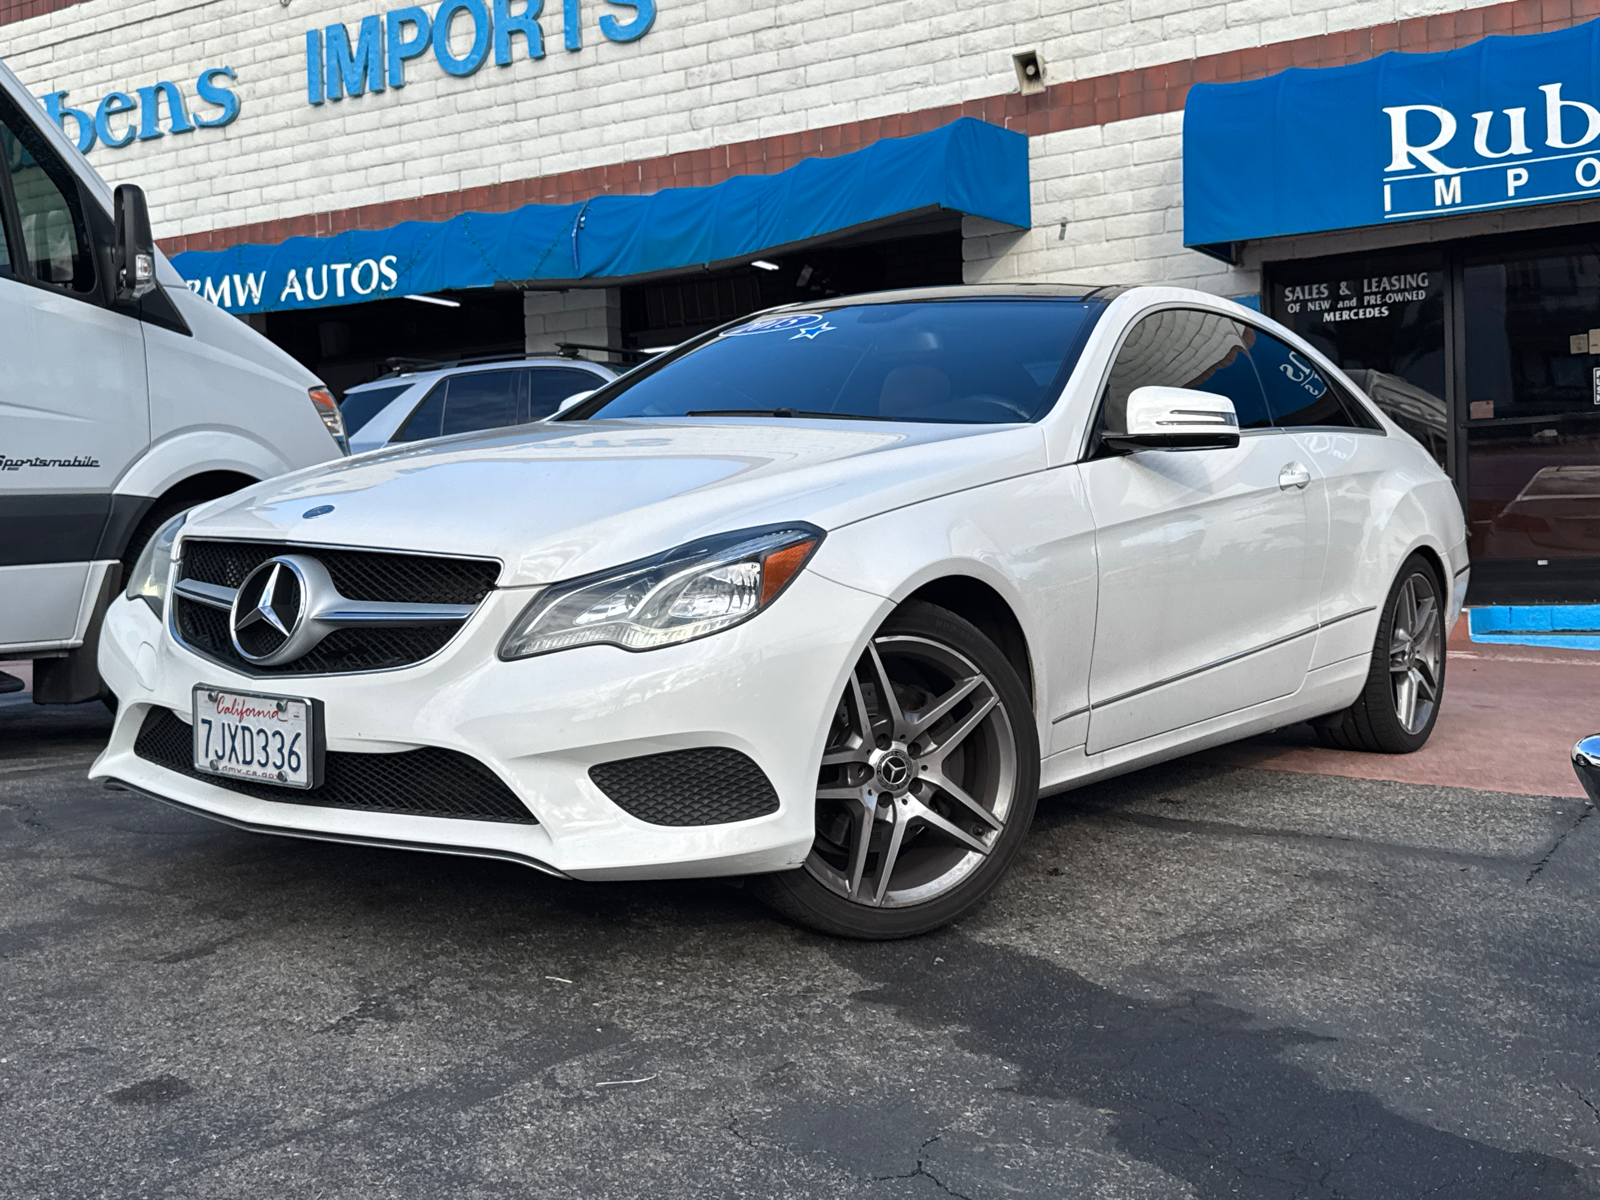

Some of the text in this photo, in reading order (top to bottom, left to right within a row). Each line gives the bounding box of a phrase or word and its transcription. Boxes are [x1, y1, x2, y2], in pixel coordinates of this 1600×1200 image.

[1382, 83, 1600, 175] Rub
[281, 255, 398, 302] AUTOS
[1284, 272, 1429, 302] SALES & LEASING
[1287, 290, 1426, 314] OF NEW and PRE-OWNED
[1322, 306, 1390, 323] MERCEDES
[216, 695, 288, 723] California
[201, 718, 302, 773] 7JXD336
